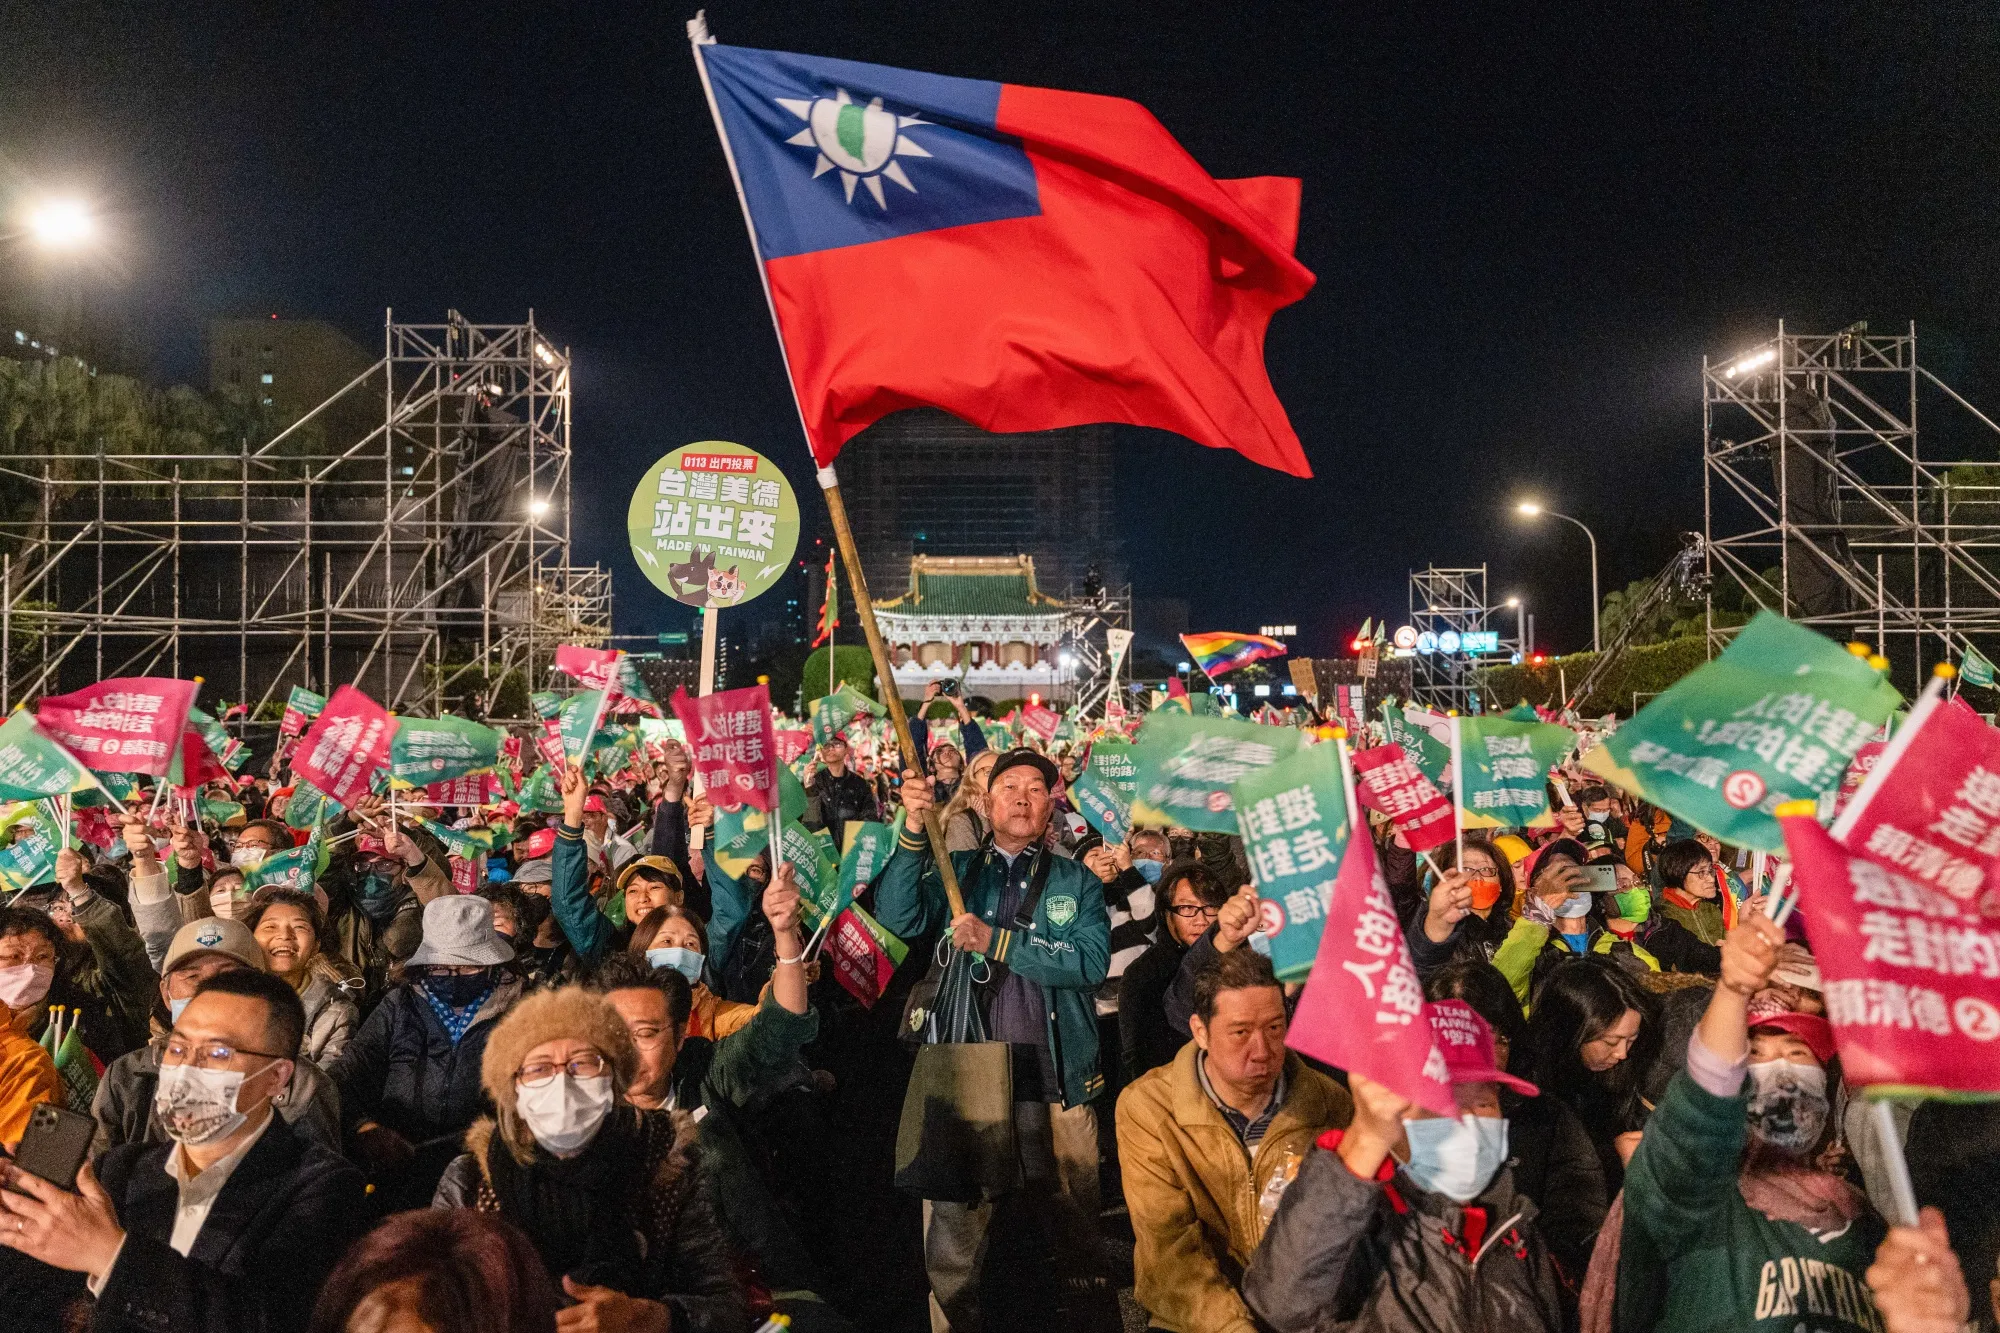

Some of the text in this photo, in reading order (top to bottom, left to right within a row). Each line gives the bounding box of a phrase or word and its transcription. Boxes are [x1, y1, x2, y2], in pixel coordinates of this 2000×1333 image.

[684, 457, 754, 470] 0113 出門投票
[657, 468, 782, 508] 台灣美德
[651, 498, 778, 550] 站出來
[656, 538, 766, 563] MADE IN TAIWAN
[1433, 1004, 1472, 1020] TEAM
[1430, 1016, 1480, 1036] TAIWAN
